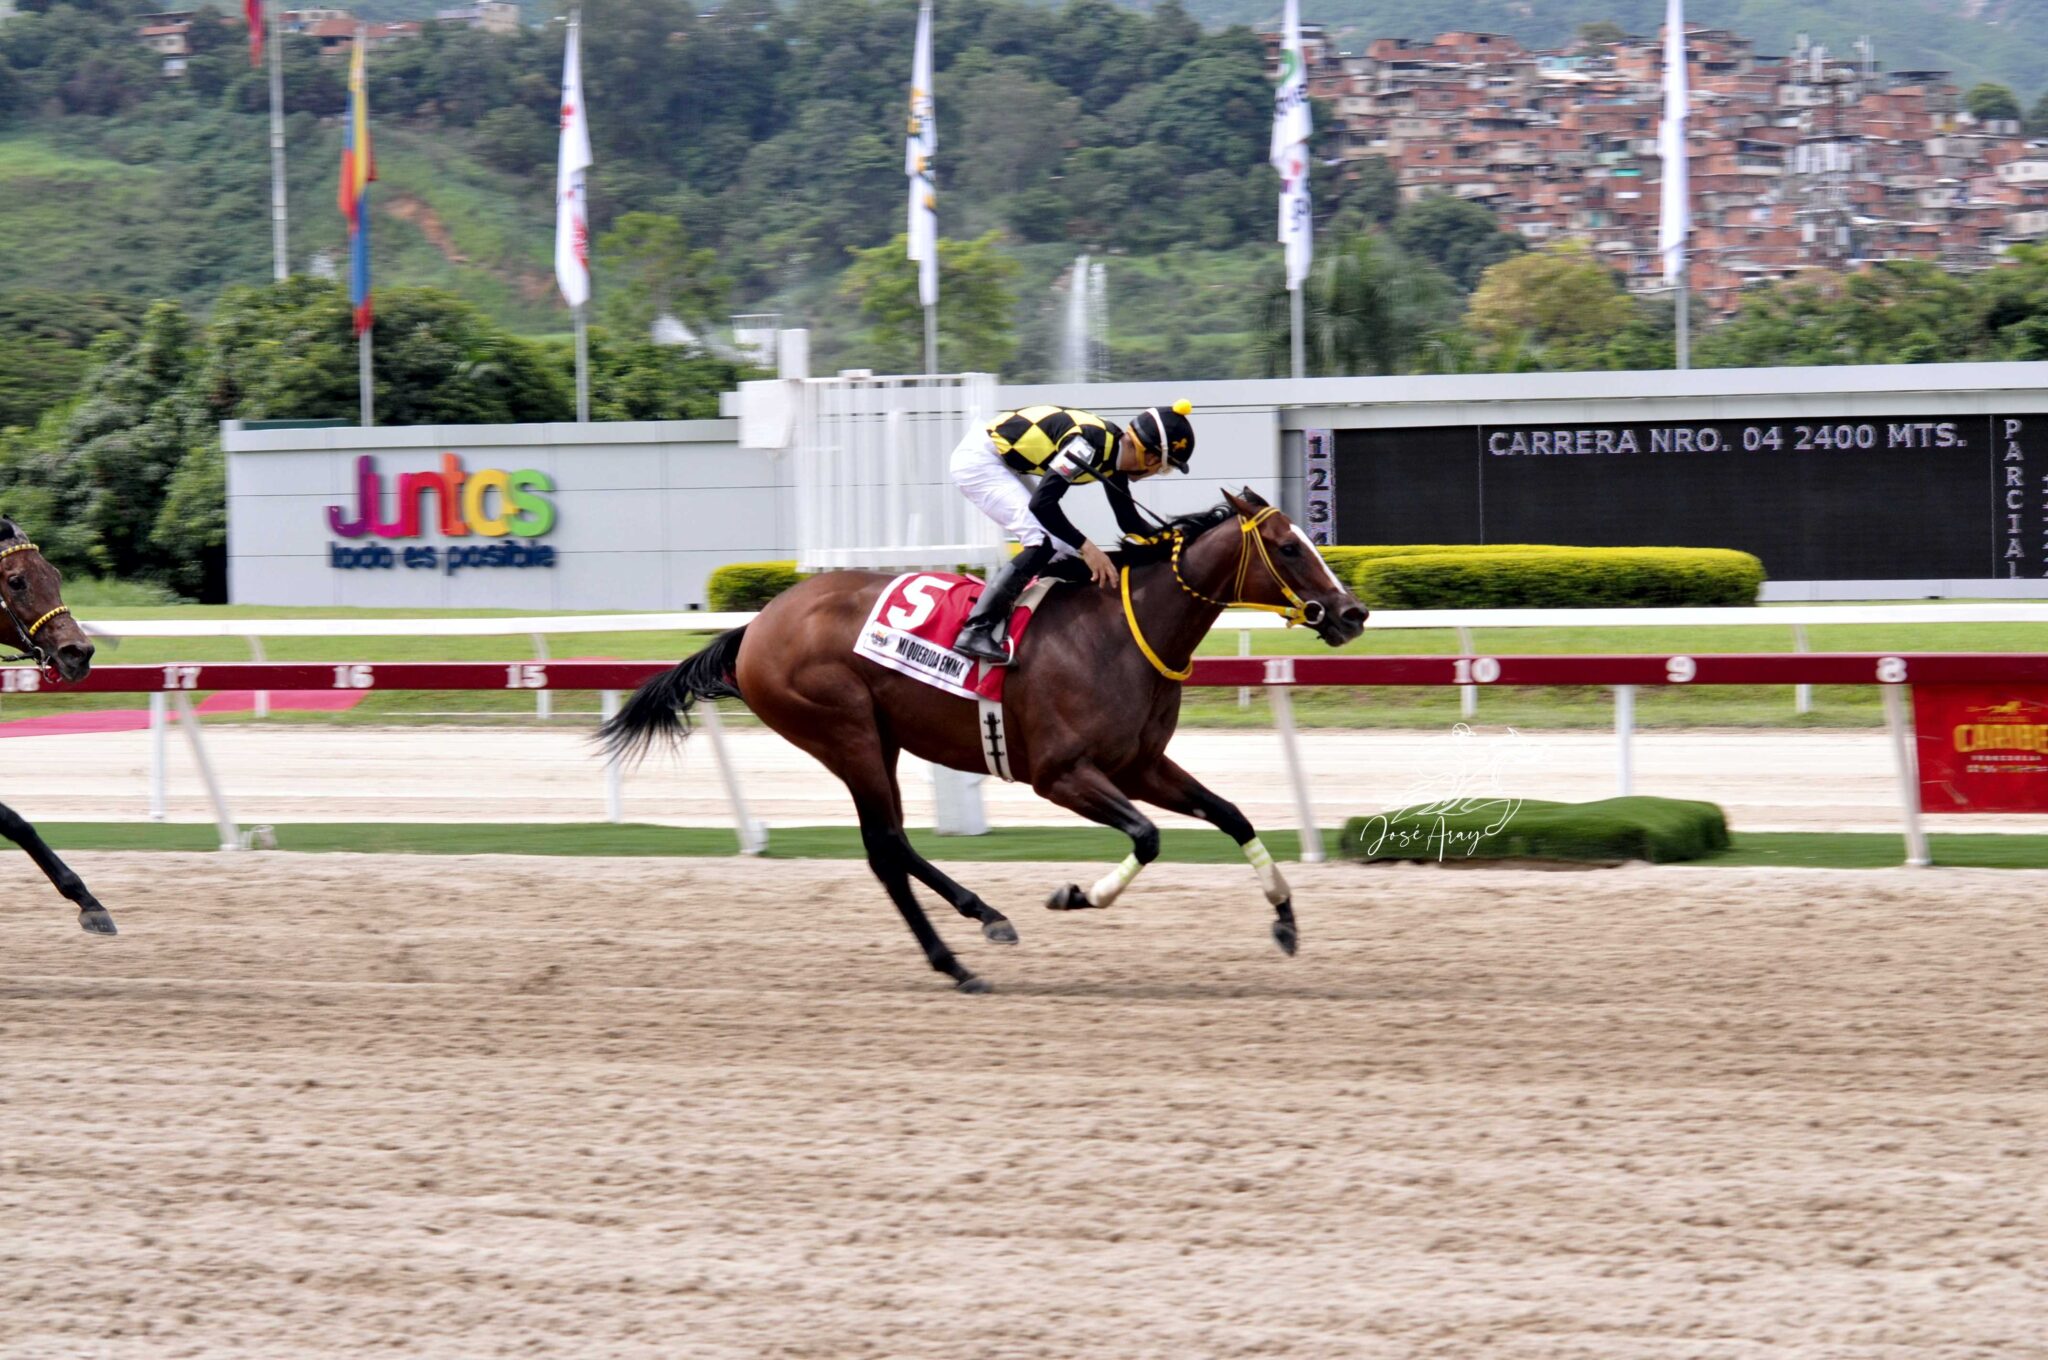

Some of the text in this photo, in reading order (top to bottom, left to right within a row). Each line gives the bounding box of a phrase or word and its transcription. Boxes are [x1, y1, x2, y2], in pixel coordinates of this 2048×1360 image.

[1309, 436, 1328, 459] 1
[1488, 422, 1969, 455] CARRERA NRO. 04 2400 MTS.
[1309, 467, 1330, 491] 2
[1308, 500, 1330, 523] 3
[328, 538, 556, 577] todo es posible
[895, 636, 910, 656] MI
[906, 641, 942, 670] QUERIDA
[938, 654, 966, 679] EMMA
[1453, 657, 1501, 684] 10
[1665, 655, 1697, 683] 9
[1875, 656, 1908, 683] 8
[162, 666, 202, 689] 17
[332, 665, 375, 689] 16
[505, 664, 548, 689] 15
[1262, 658, 1297, 684] 11
